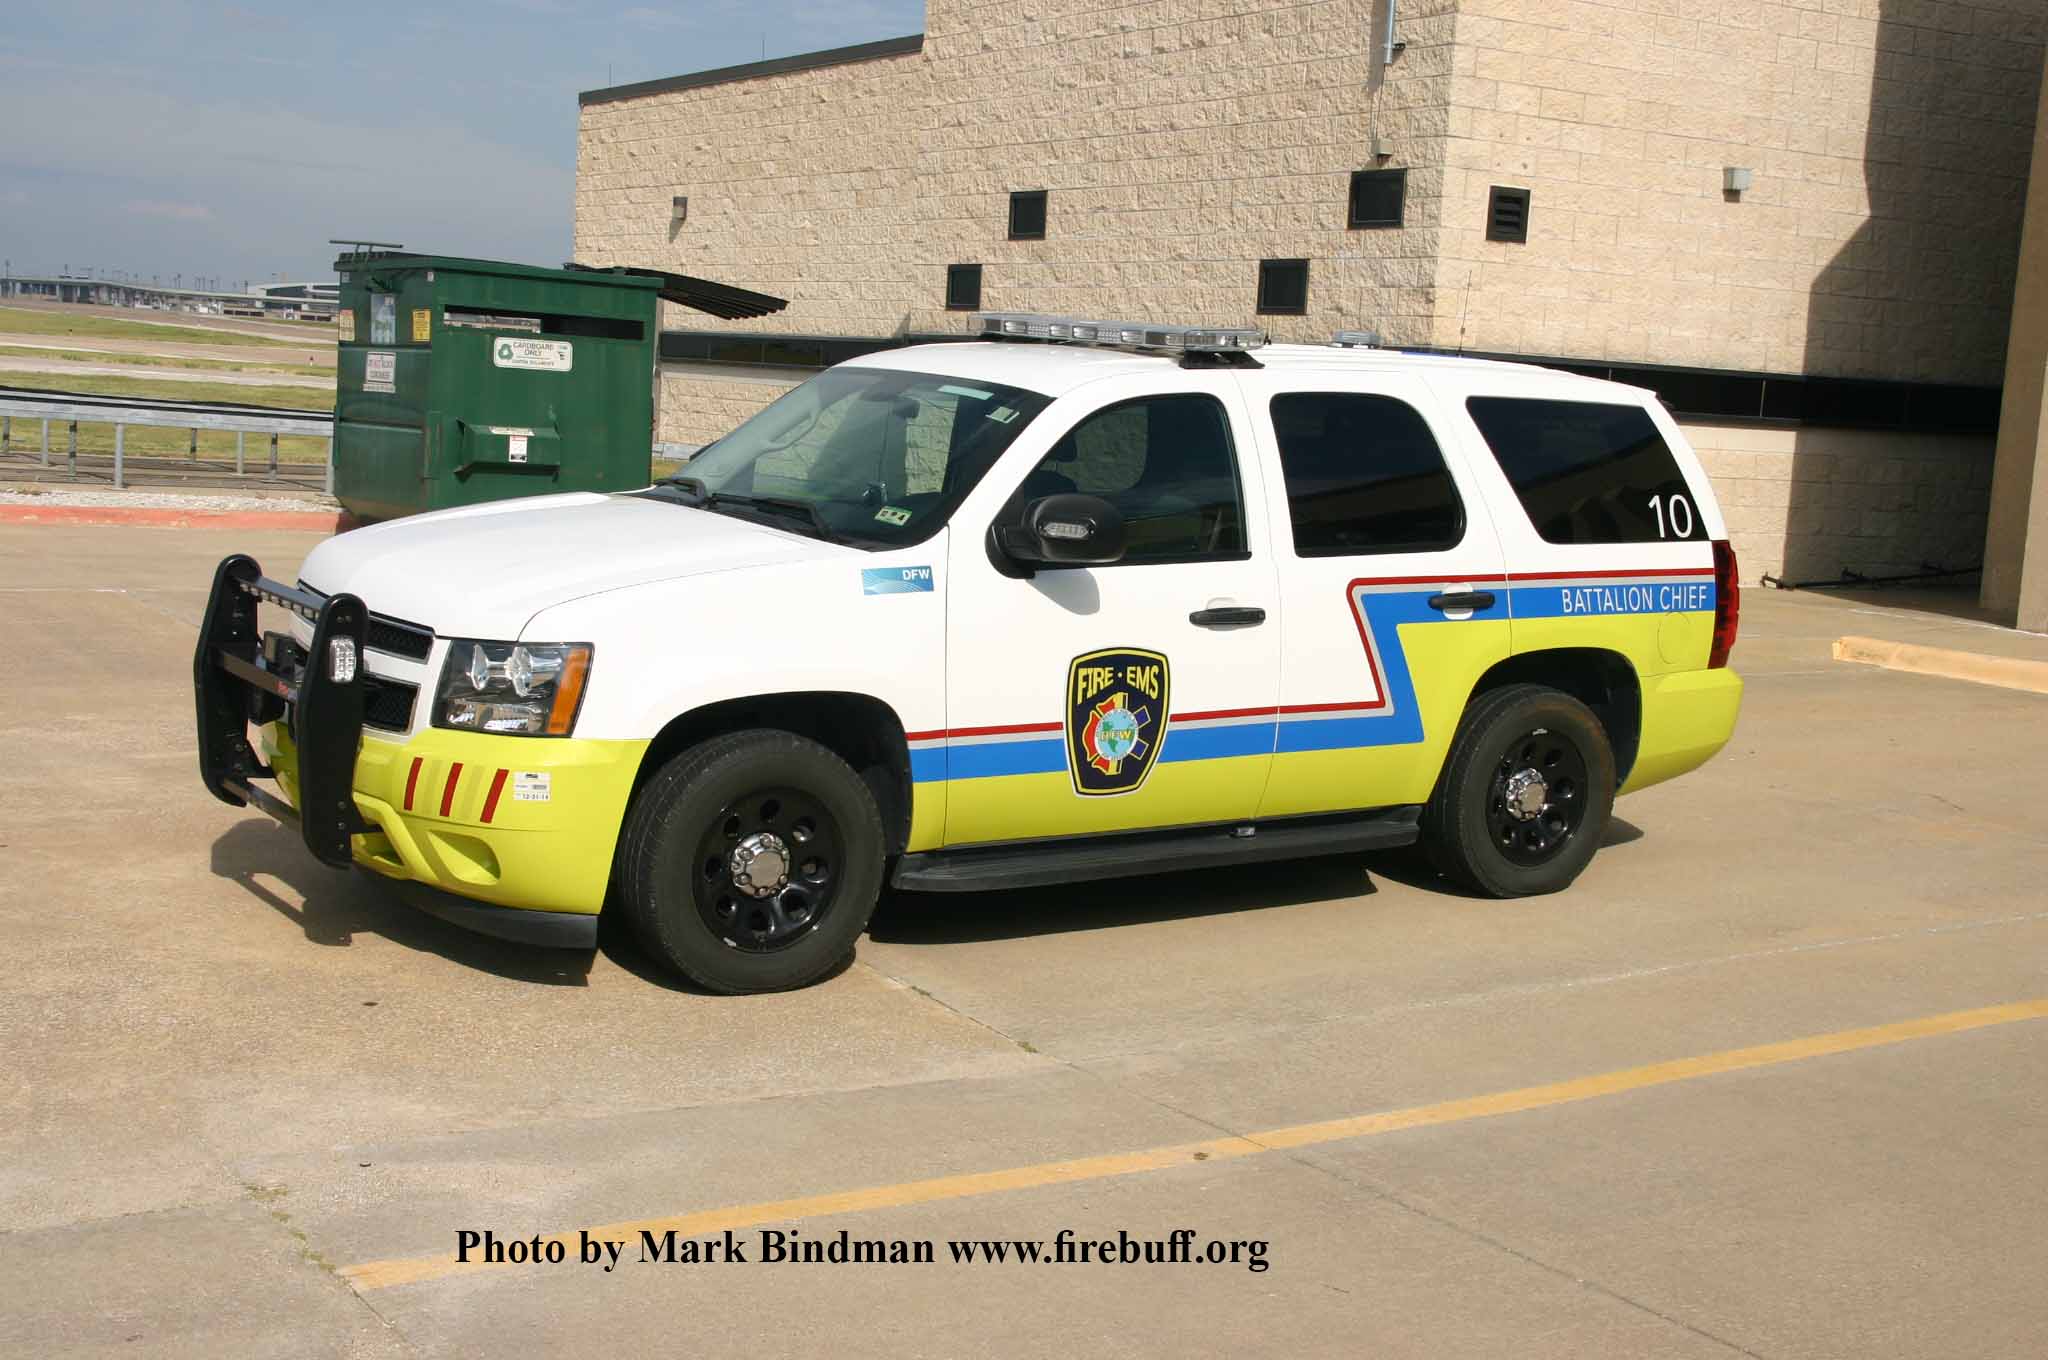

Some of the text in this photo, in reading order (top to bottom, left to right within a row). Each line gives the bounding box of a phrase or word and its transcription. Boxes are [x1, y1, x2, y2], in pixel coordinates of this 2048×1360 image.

[513, 342, 554, 352] CARDBOARD
[524, 348, 543, 357] ONLY
[1648, 494, 1693, 539] 10
[902, 568, 930, 580] DFW
[1561, 585, 1708, 614] BATTALION CHIEF
[1077, 664, 1160, 705] FIRE EMS
